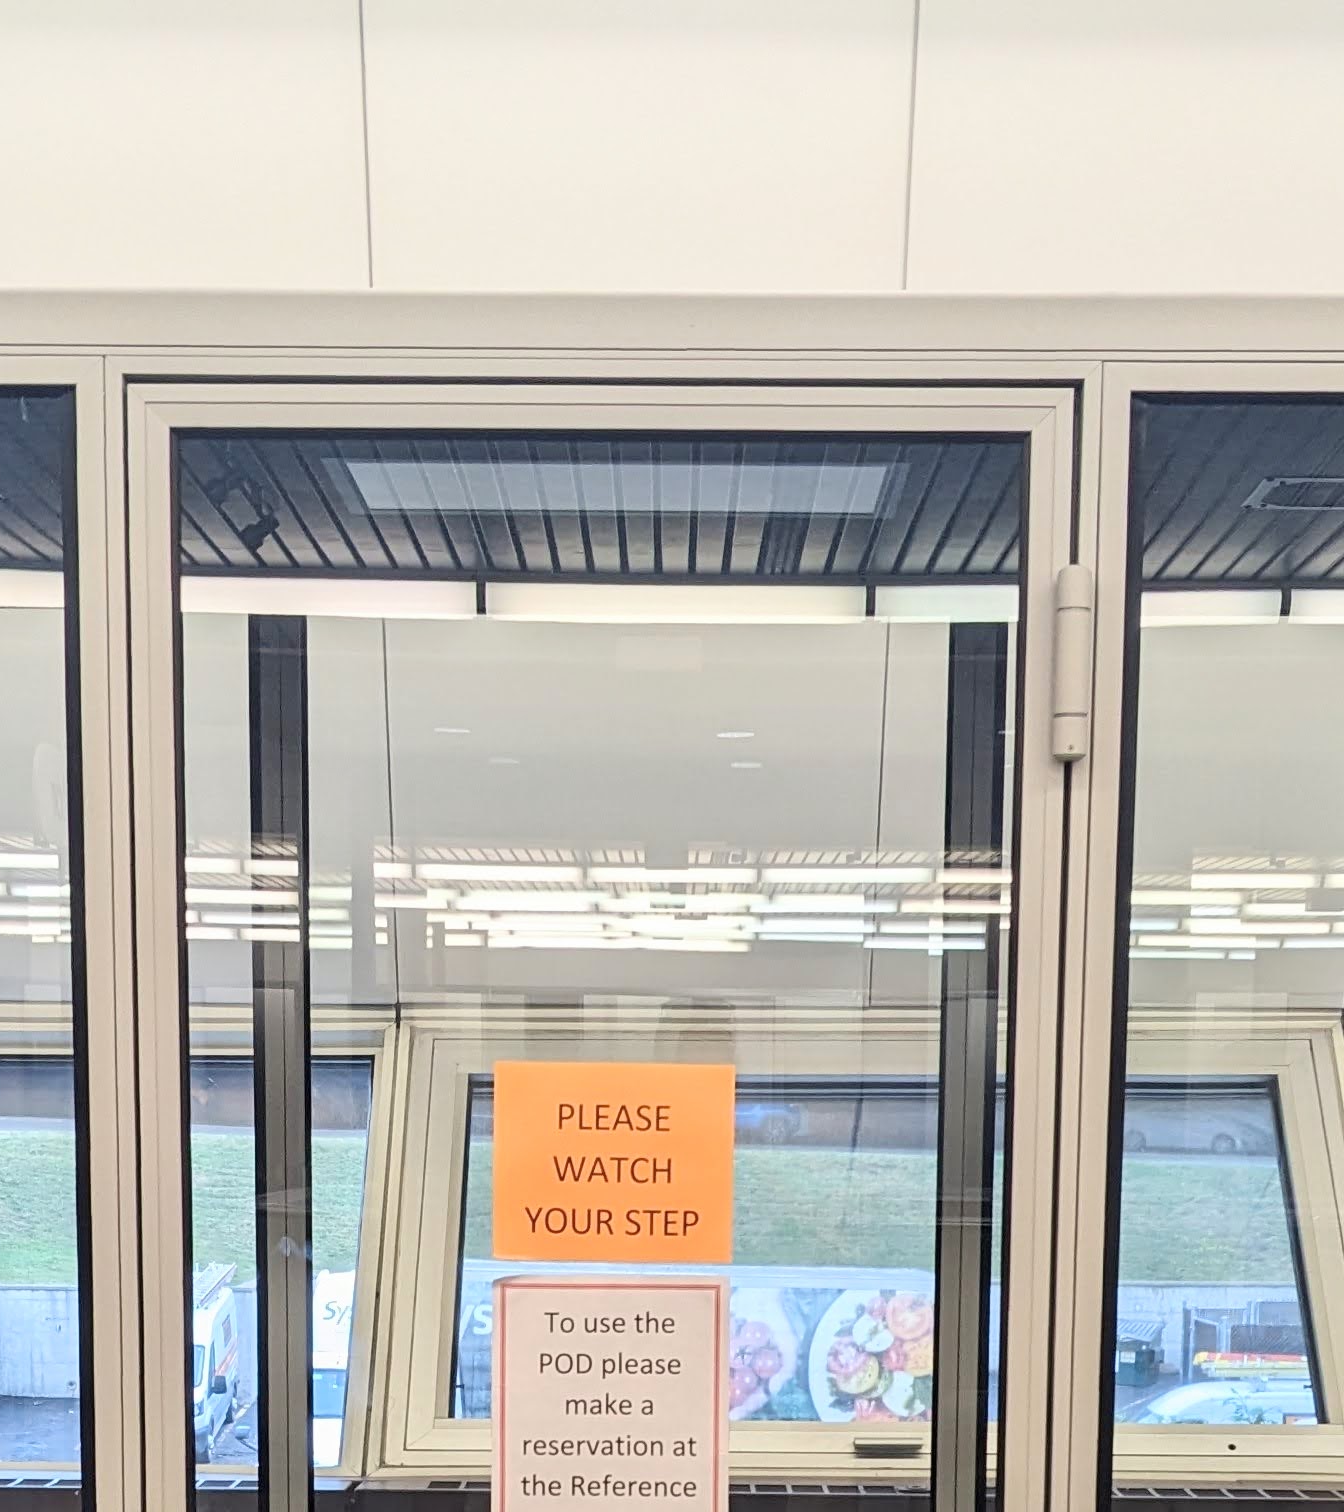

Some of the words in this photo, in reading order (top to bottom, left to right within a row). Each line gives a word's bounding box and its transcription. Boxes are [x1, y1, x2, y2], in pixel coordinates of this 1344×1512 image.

[558, 1103, 671, 1132] PLEASE
[553, 1155, 672, 1184] WATCH
[524, 1206, 614, 1236] YOUR
[625, 1209, 699, 1237] STEP
[544, 1312, 575, 1334] To
[584, 1317, 626, 1334] use
[634, 1311, 675, 1334] the
[539, 1352, 593, 1375] POD
[602, 1351, 681, 1380] please
[565, 1392, 633, 1416] make
[641, 1399, 654, 1416] a
[523, 1434, 664, 1457] reservation
[672, 1437, 697, 1457] at
[520, 1473, 562, 1497] the
[571, 1474, 697, 1498] Reference
